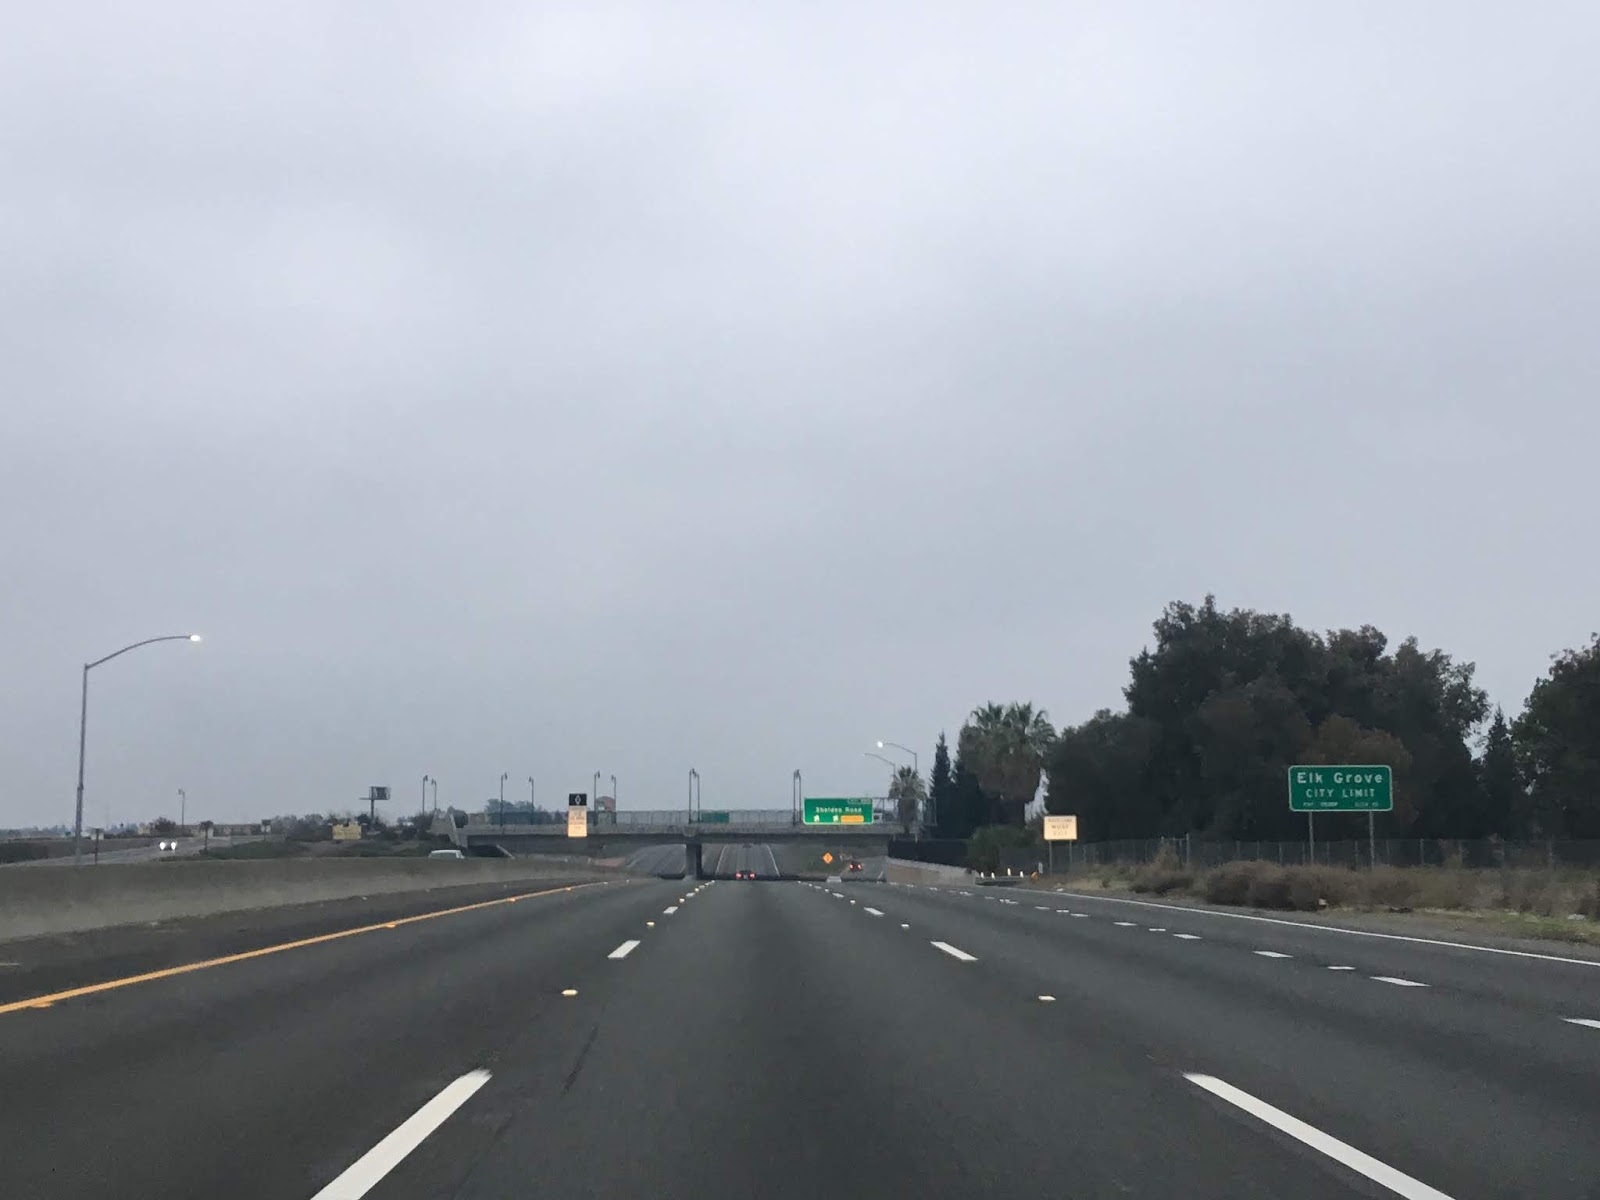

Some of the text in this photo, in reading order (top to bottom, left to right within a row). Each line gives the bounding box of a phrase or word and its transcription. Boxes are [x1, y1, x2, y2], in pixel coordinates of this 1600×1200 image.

[1297, 772, 1383, 784] Elk Grove
[1305, 788, 1375, 798] CITY LIMIT
